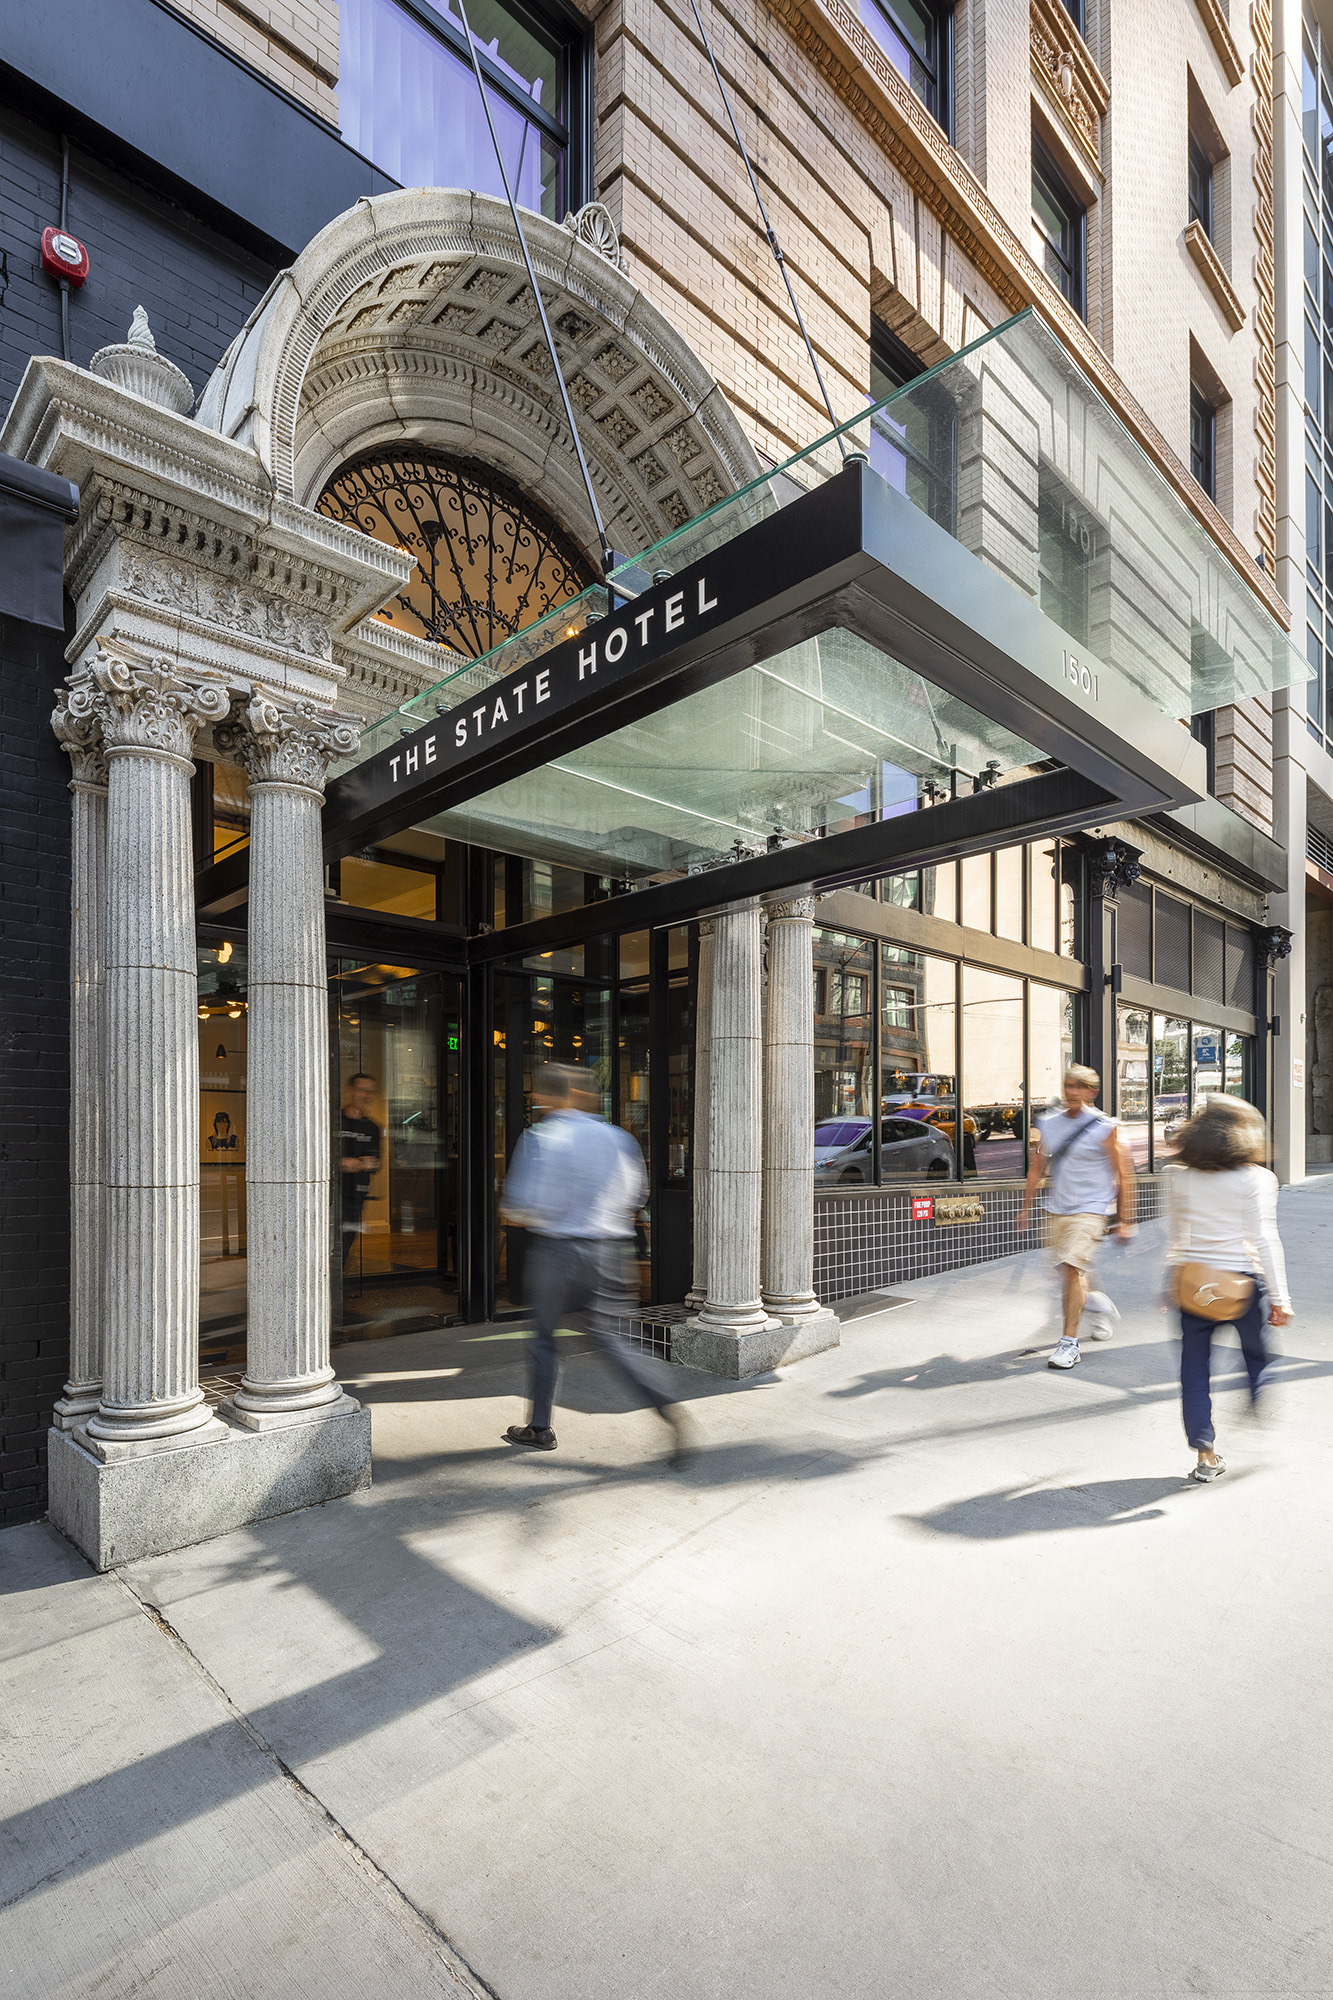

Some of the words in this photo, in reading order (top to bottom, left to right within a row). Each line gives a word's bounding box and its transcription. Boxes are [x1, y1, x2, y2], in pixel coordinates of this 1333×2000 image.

[389, 734, 437, 783] THE
[455, 668, 551, 748] STATE
[578, 577, 718, 681] HOTEL
[1062, 649, 1099, 702] 1501
